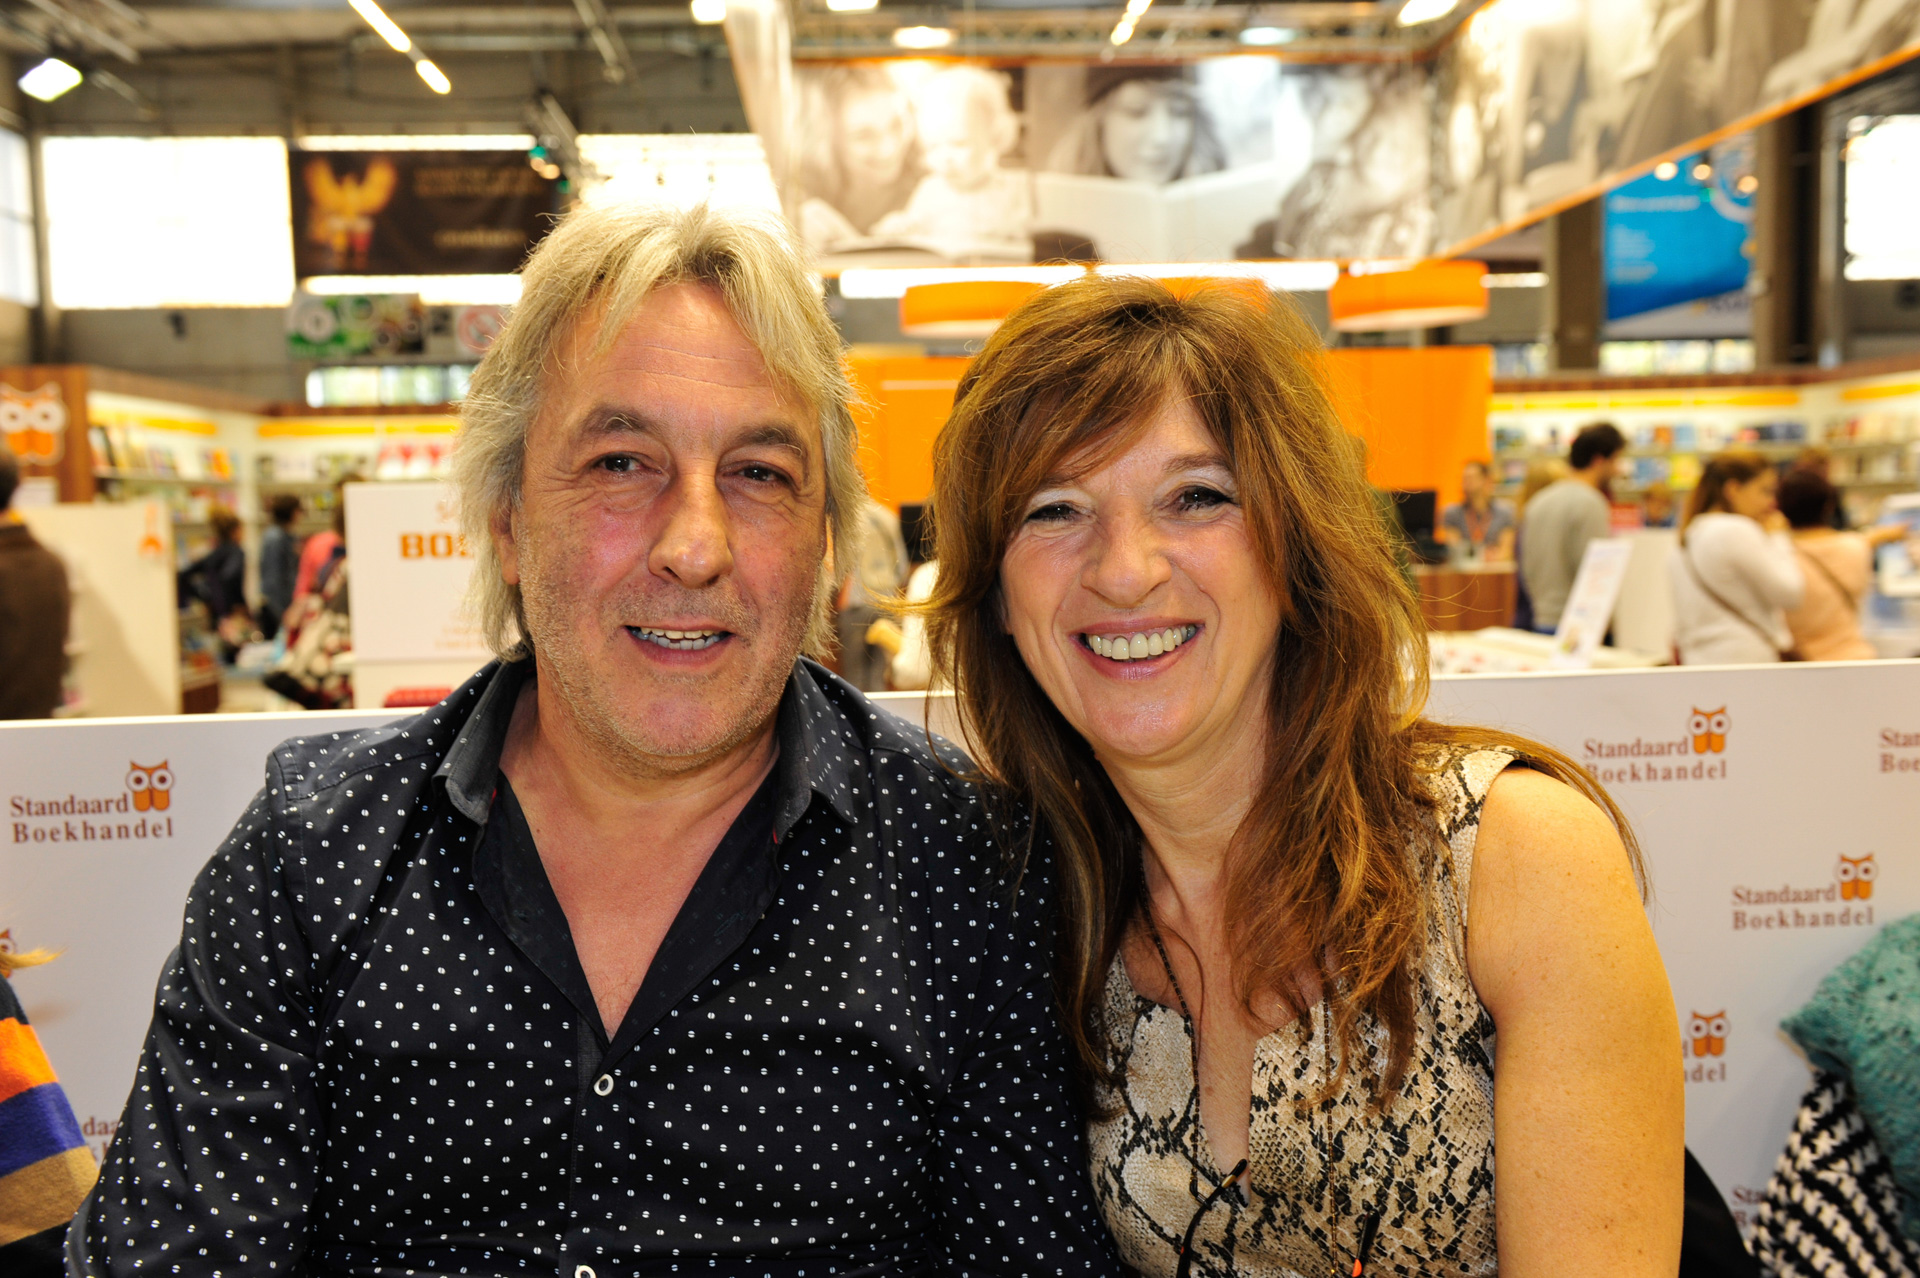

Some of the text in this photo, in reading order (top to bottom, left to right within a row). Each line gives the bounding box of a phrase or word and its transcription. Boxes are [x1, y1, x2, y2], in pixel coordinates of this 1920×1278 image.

[1584, 736, 1689, 758] Standaard
[10, 793, 129, 817] Standaard
[13, 817, 173, 844] Boekhandel
[1732, 883, 1837, 906] Standaard
[1733, 906, 1875, 930] Boekhandel
